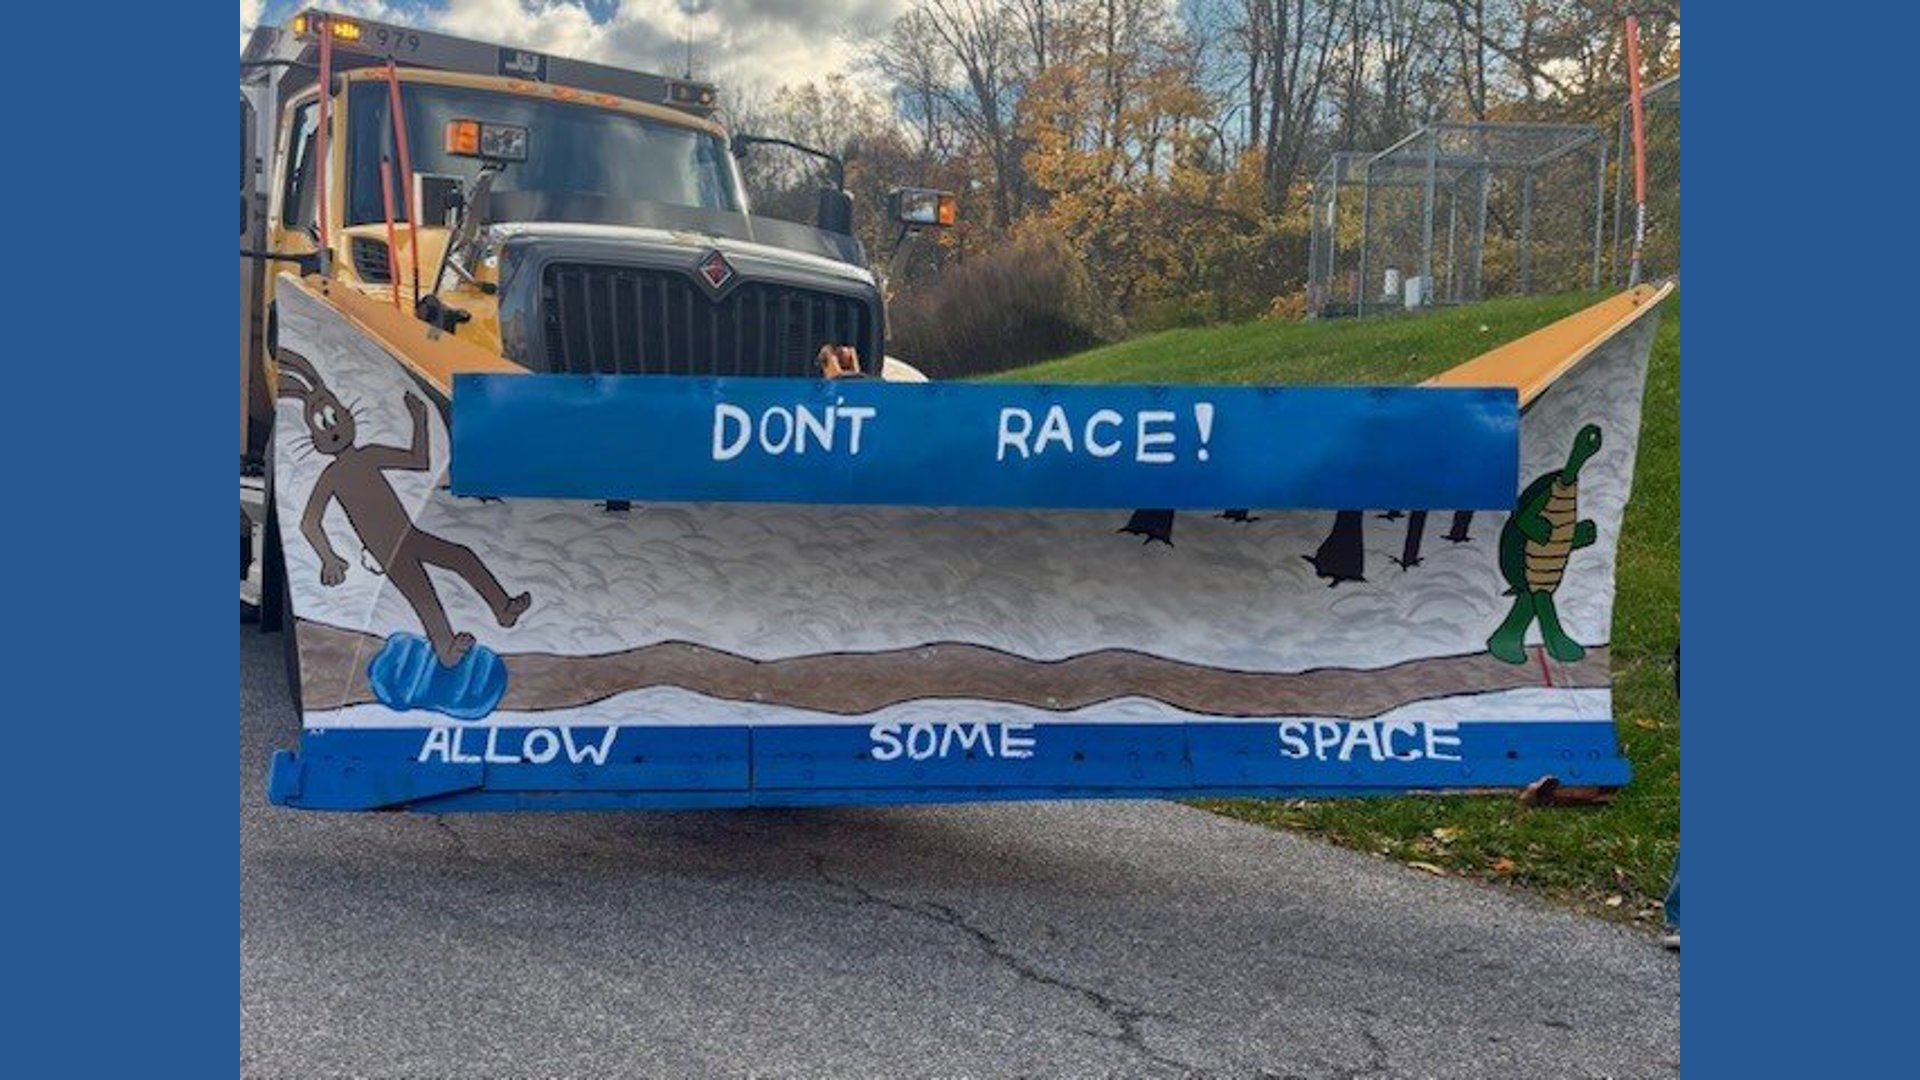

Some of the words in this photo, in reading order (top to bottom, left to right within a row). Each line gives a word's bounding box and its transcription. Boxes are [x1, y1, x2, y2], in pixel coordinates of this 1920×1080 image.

[376, 29, 421, 53] 979
[997, 402, 1215, 463] RACE!
[418, 726, 617, 765] ALLOW
[869, 722, 1036, 761] SOME
[1278, 721, 1463, 762] SPACE
